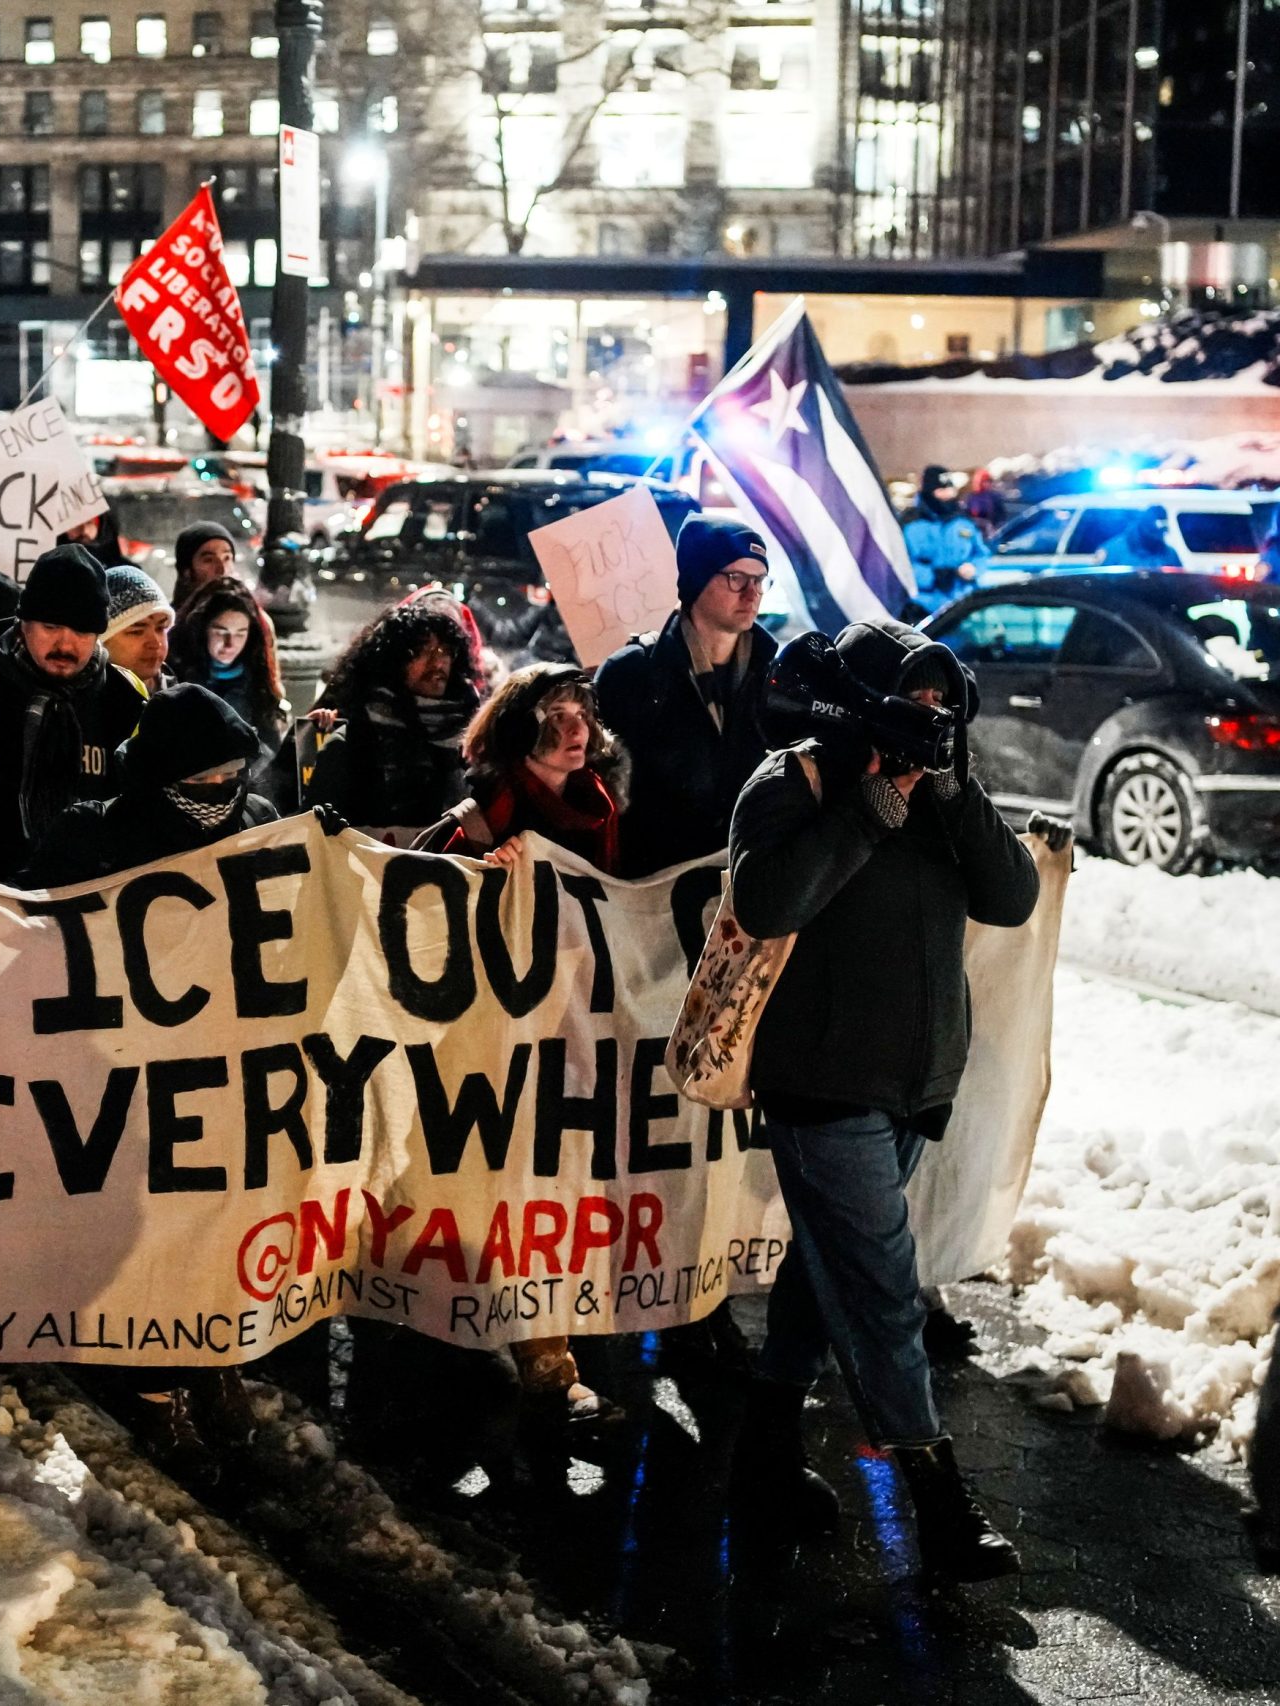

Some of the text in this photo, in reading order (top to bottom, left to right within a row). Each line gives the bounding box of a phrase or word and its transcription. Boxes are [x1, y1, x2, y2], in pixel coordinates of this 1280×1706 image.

[147, 257, 258, 380] LIBERATION
[170, 234, 245, 327] SOCIAL
[121, 278, 244, 411] FRSO
[551, 519, 649, 597] FUCK
[576, 571, 669, 637] ICE
[22, 843, 312, 1035] ICE
[377, 853, 615, 1023] OUT
[27, 1308, 259, 1353] ALLIANCE
[268, 1268, 420, 1336] AGAINST
[450, 1278, 563, 1338] RACIST
[573, 1280, 601, 1315] &
[613, 1256, 723, 1312] POLITICA
[727, 1238, 786, 1276] REP
[236, 1187, 664, 1302] @NYAARPR
